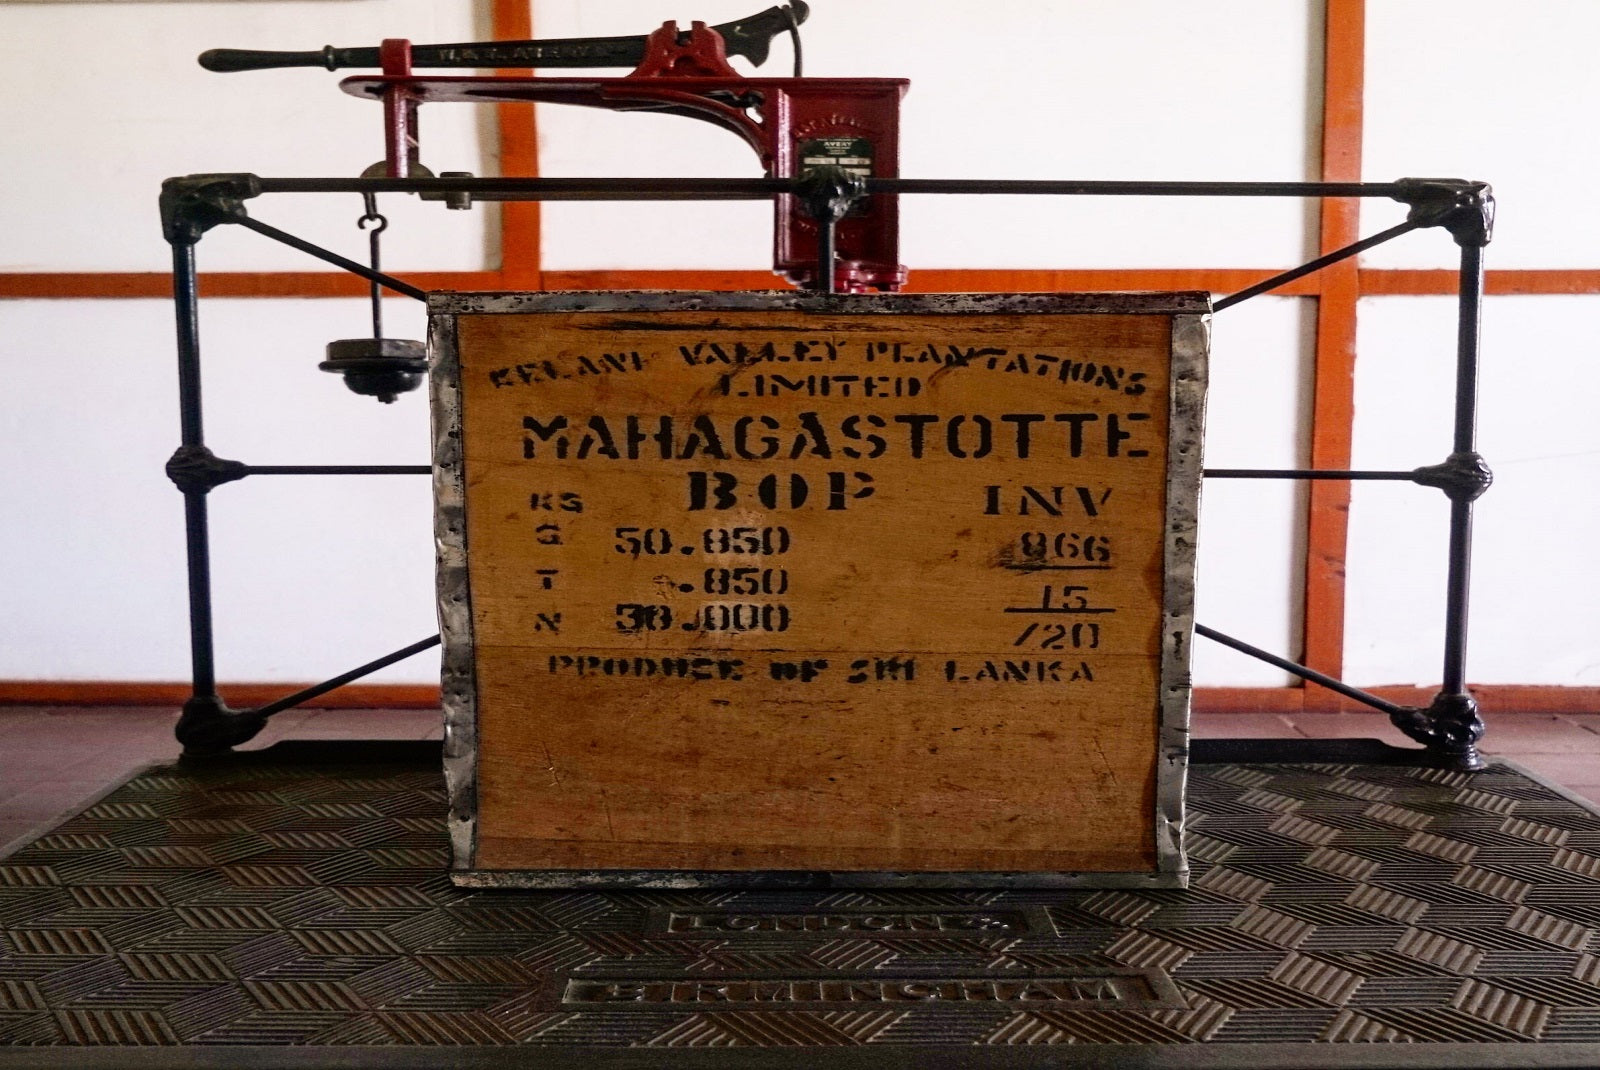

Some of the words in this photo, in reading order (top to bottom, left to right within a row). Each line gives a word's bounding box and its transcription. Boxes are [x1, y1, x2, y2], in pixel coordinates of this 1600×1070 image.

[679, 340, 846, 366] VALLEY
[866, 341, 1148, 396] PLANTATIONS
[719, 374, 921, 397] LIMITED
[522, 411, 1151, 461] MAHAGASTOTTE
[687, 470, 875, 511] BOP
[982, 485, 1113, 517] INV
[614, 526, 791, 556] 50.850
[1020, 531, 1111, 562] 866
[535, 568, 560, 590] T
[1041, 584, 1089, 611] 15
[534, 611, 562, 633] N
[769, 658, 829, 683] OF
[846, 656, 915, 684] SRI
[943, 659, 1094, 683] LANKA
[688, 913, 944, 931] LONDON
[605, 979, 1122, 1002] BIRMINGHAM
